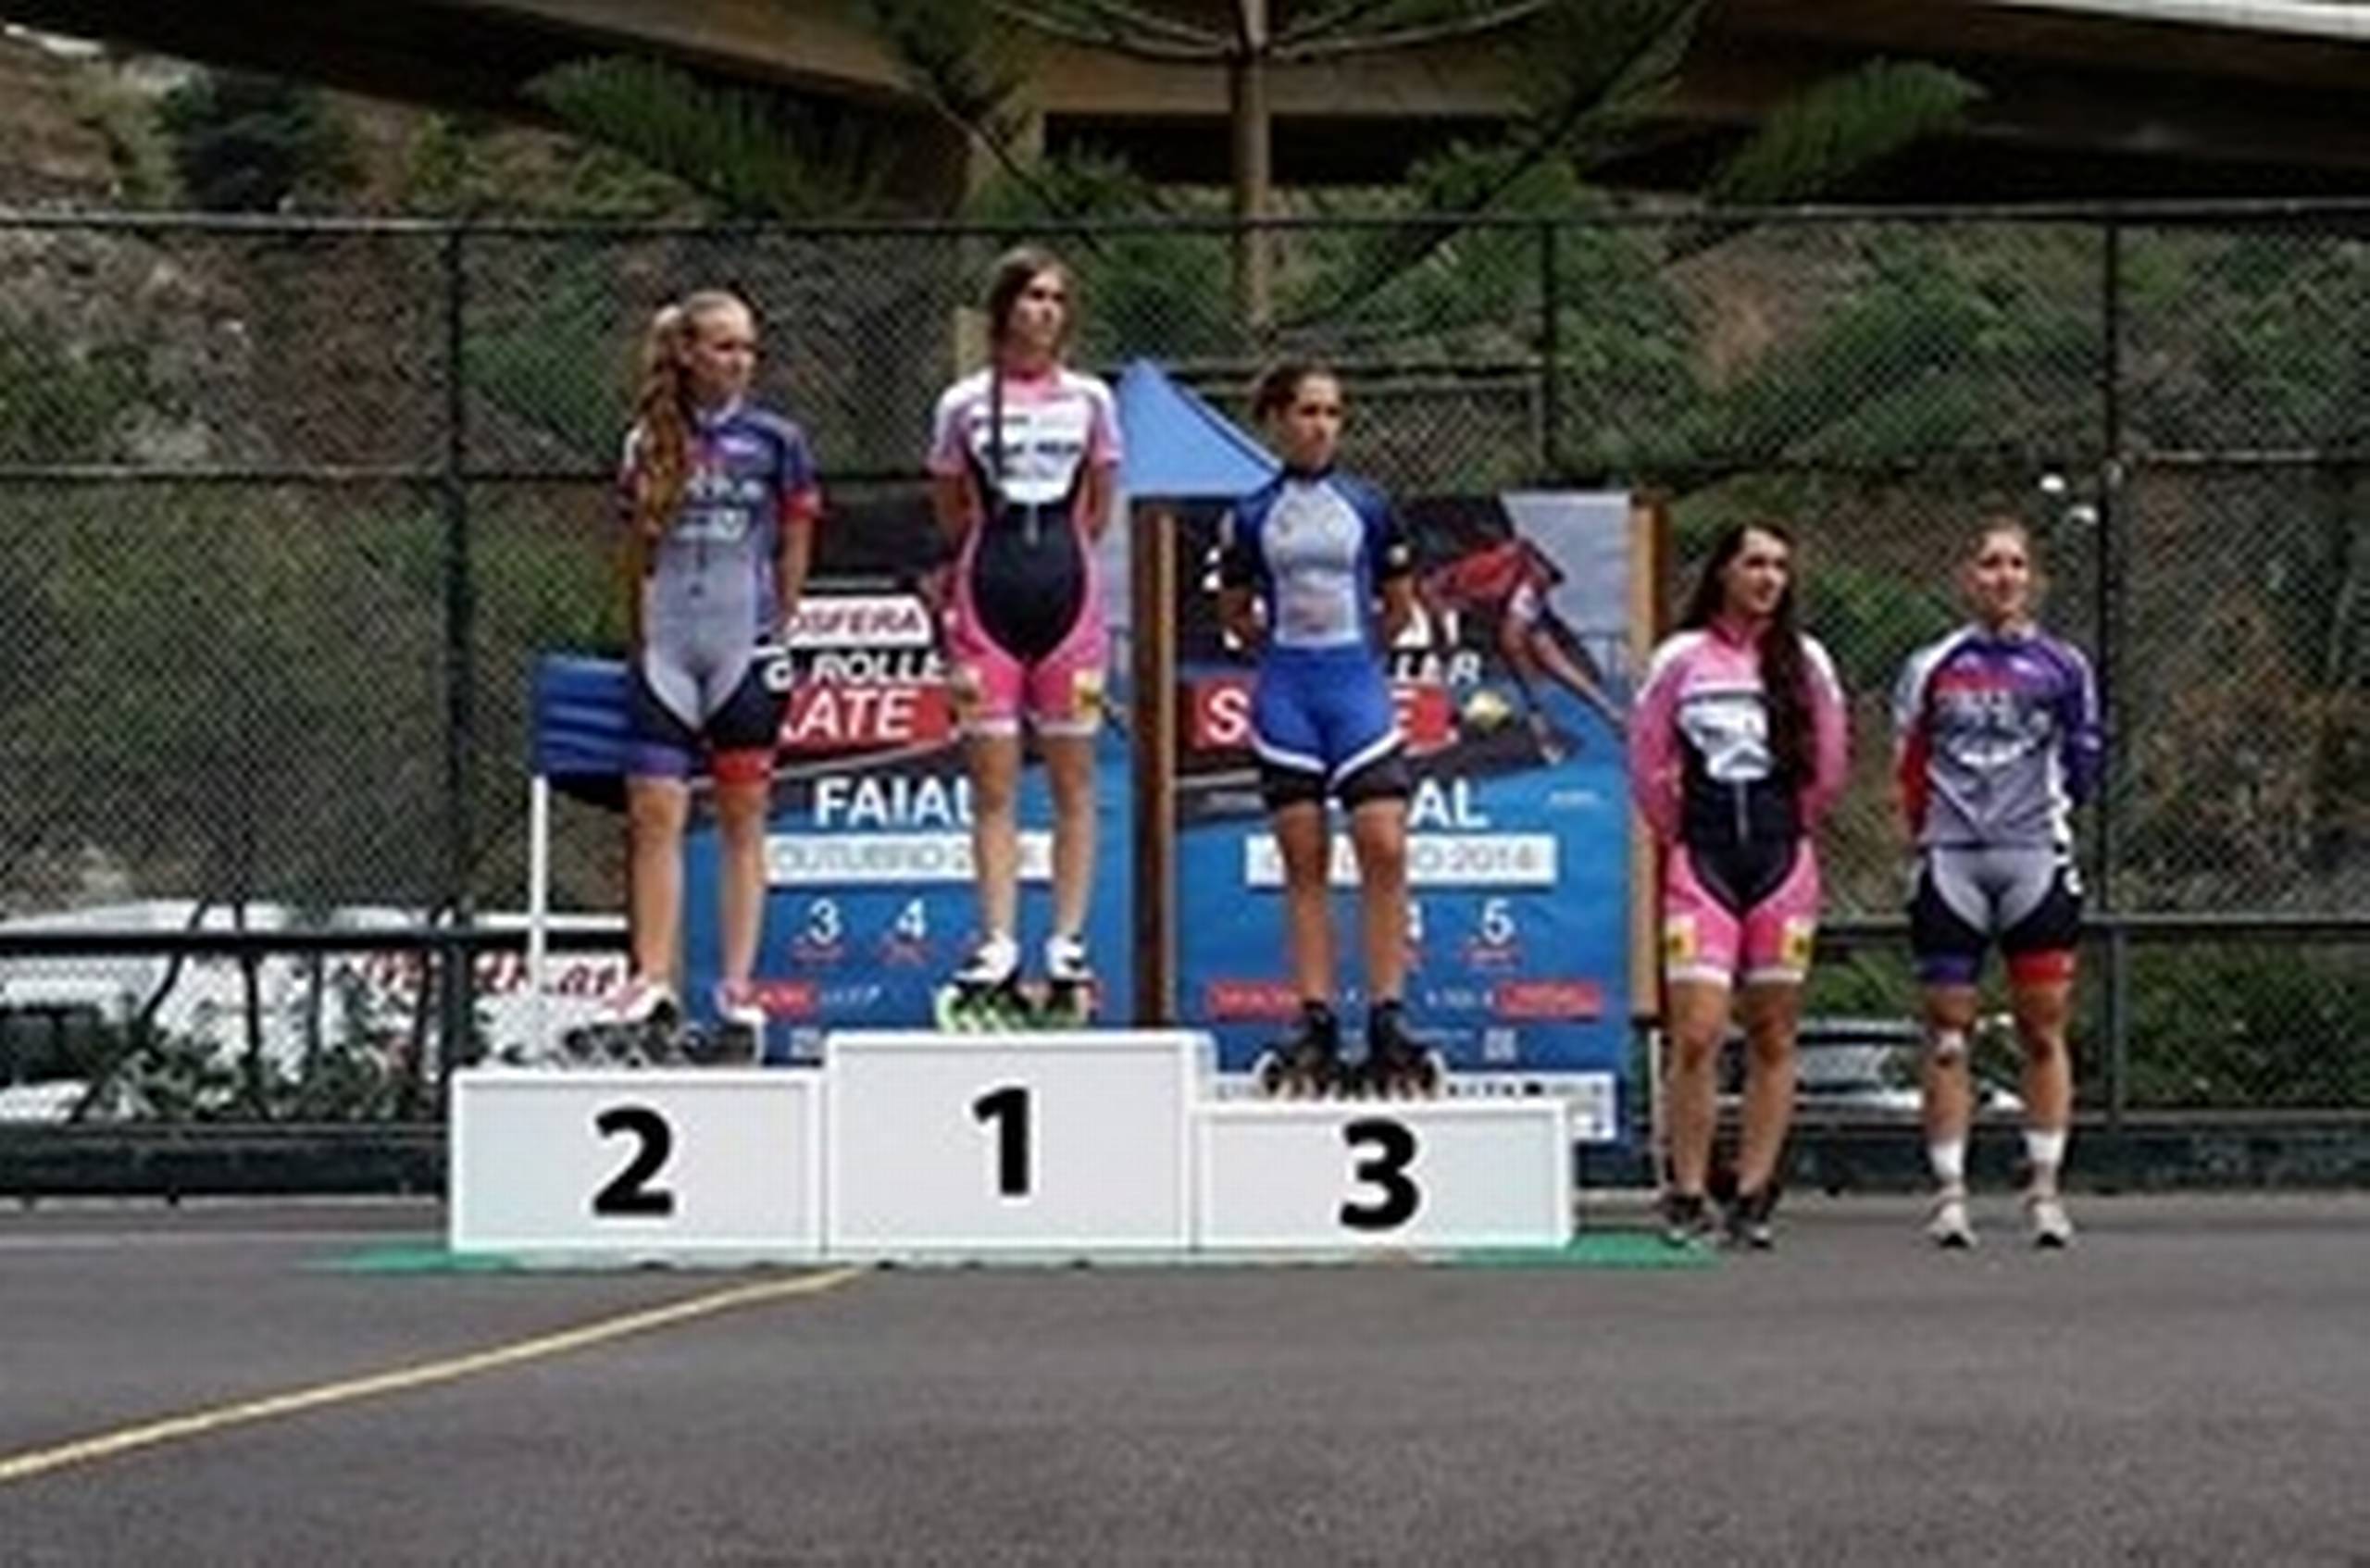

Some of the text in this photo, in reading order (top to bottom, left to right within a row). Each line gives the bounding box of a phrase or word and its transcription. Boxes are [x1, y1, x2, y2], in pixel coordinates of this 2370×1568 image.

[783, 687, 919, 740] ATE
[808, 897, 927, 944] 3 4
[1482, 898, 1516, 945] 5
[592, 1106, 674, 1217] 2
[973, 1087, 1029, 1197] 1
[1339, 1117, 1420, 1232] 3
